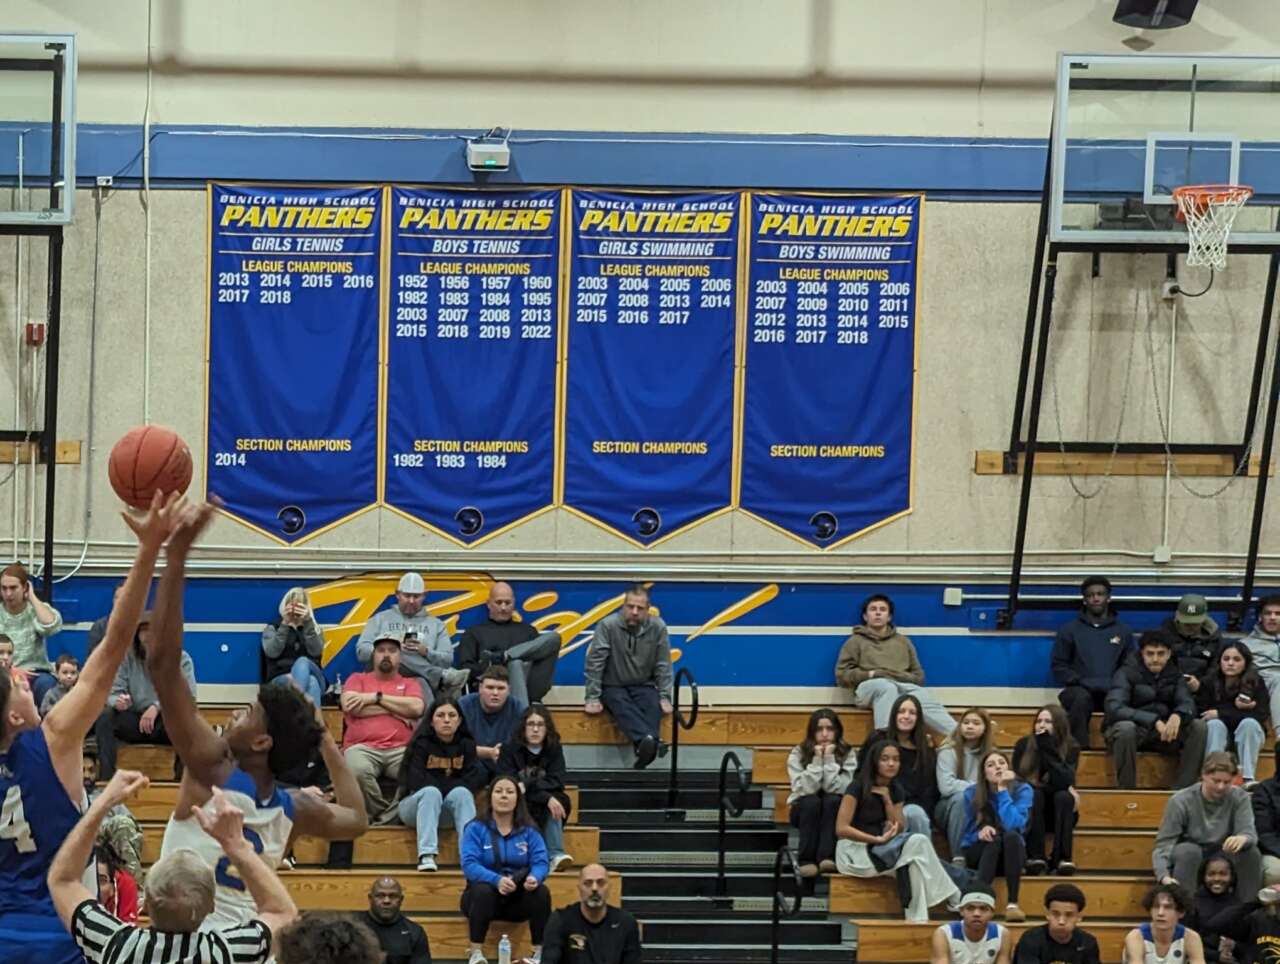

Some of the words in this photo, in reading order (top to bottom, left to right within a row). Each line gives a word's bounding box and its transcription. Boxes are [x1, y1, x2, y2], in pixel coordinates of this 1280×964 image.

[759, 203, 814, 213] BENICIA
[821, 205, 855, 214] HIGH
[862, 205, 913, 214] SCHOOL
[220, 207, 375, 228] PANTHERS
[399, 209, 554, 230] PANTHERS
[579, 211, 734, 233] PANTHERS
[758, 215, 912, 237] PANTHERS
[252, 237, 292, 251] GIRLS
[296, 238, 344, 252] TENNIS
[432, 239, 468, 253] BOYS
[473, 240, 520, 254] TENNIS
[599, 241, 639, 255] GIRLS
[641, 242, 714, 256] SWIMMING
[779, 245, 815, 259] BOYS
[818, 246, 891, 260] SWIMMING
[242, 260, 284, 272] LEAGUE
[287, 261, 353, 273] CHAMPIONS
[420, 262, 462, 274] LEAGUE
[465, 263, 530, 275] CHAMPIONS
[600, 264, 642, 276] LEAGUE
[645, 265, 710, 277] CHAMPIONS
[219, 272, 249, 286] 2013
[260, 273, 291, 287] 2014
[302, 274, 332, 287] 2015
[343, 275, 374, 288] 2016
[398, 275, 428, 288] 1952
[440, 276, 469, 289] 1956
[481, 276, 511, 289] 1957
[522, 276, 552, 289] 1960
[779, 268, 821, 280] LEAGUE
[823, 269, 889, 281] CHAMPIONS
[578, 276, 608, 290] 2003
[619, 277, 649, 291] 2004
[660, 278, 690, 291] 2005
[701, 278, 731, 291] 2006
[756, 280, 787, 294] 2003
[797, 281, 828, 295] 2004
[839, 282, 869, 295] 2005
[880, 282, 910, 296] 2006
[218, 289, 249, 302] 2017
[260, 290, 291, 303] 2018
[755, 296, 786, 309] 2007
[797, 298, 827, 311] 2009
[838, 298, 868, 311] 2010
[879, 298, 907, 312] 2011
[577, 309, 607, 322] 2015
[618, 310, 648, 324] 2016
[659, 311, 690, 324] 2017
[414, 440, 461, 452] SECTION
[463, 441, 528, 453] CHAMPIONS
[593, 441, 640, 453] SECTION
[642, 442, 707, 454] CHAMPIONS
[215, 453, 246, 466] 2014
[388, 622, 430, 634] BENIA
